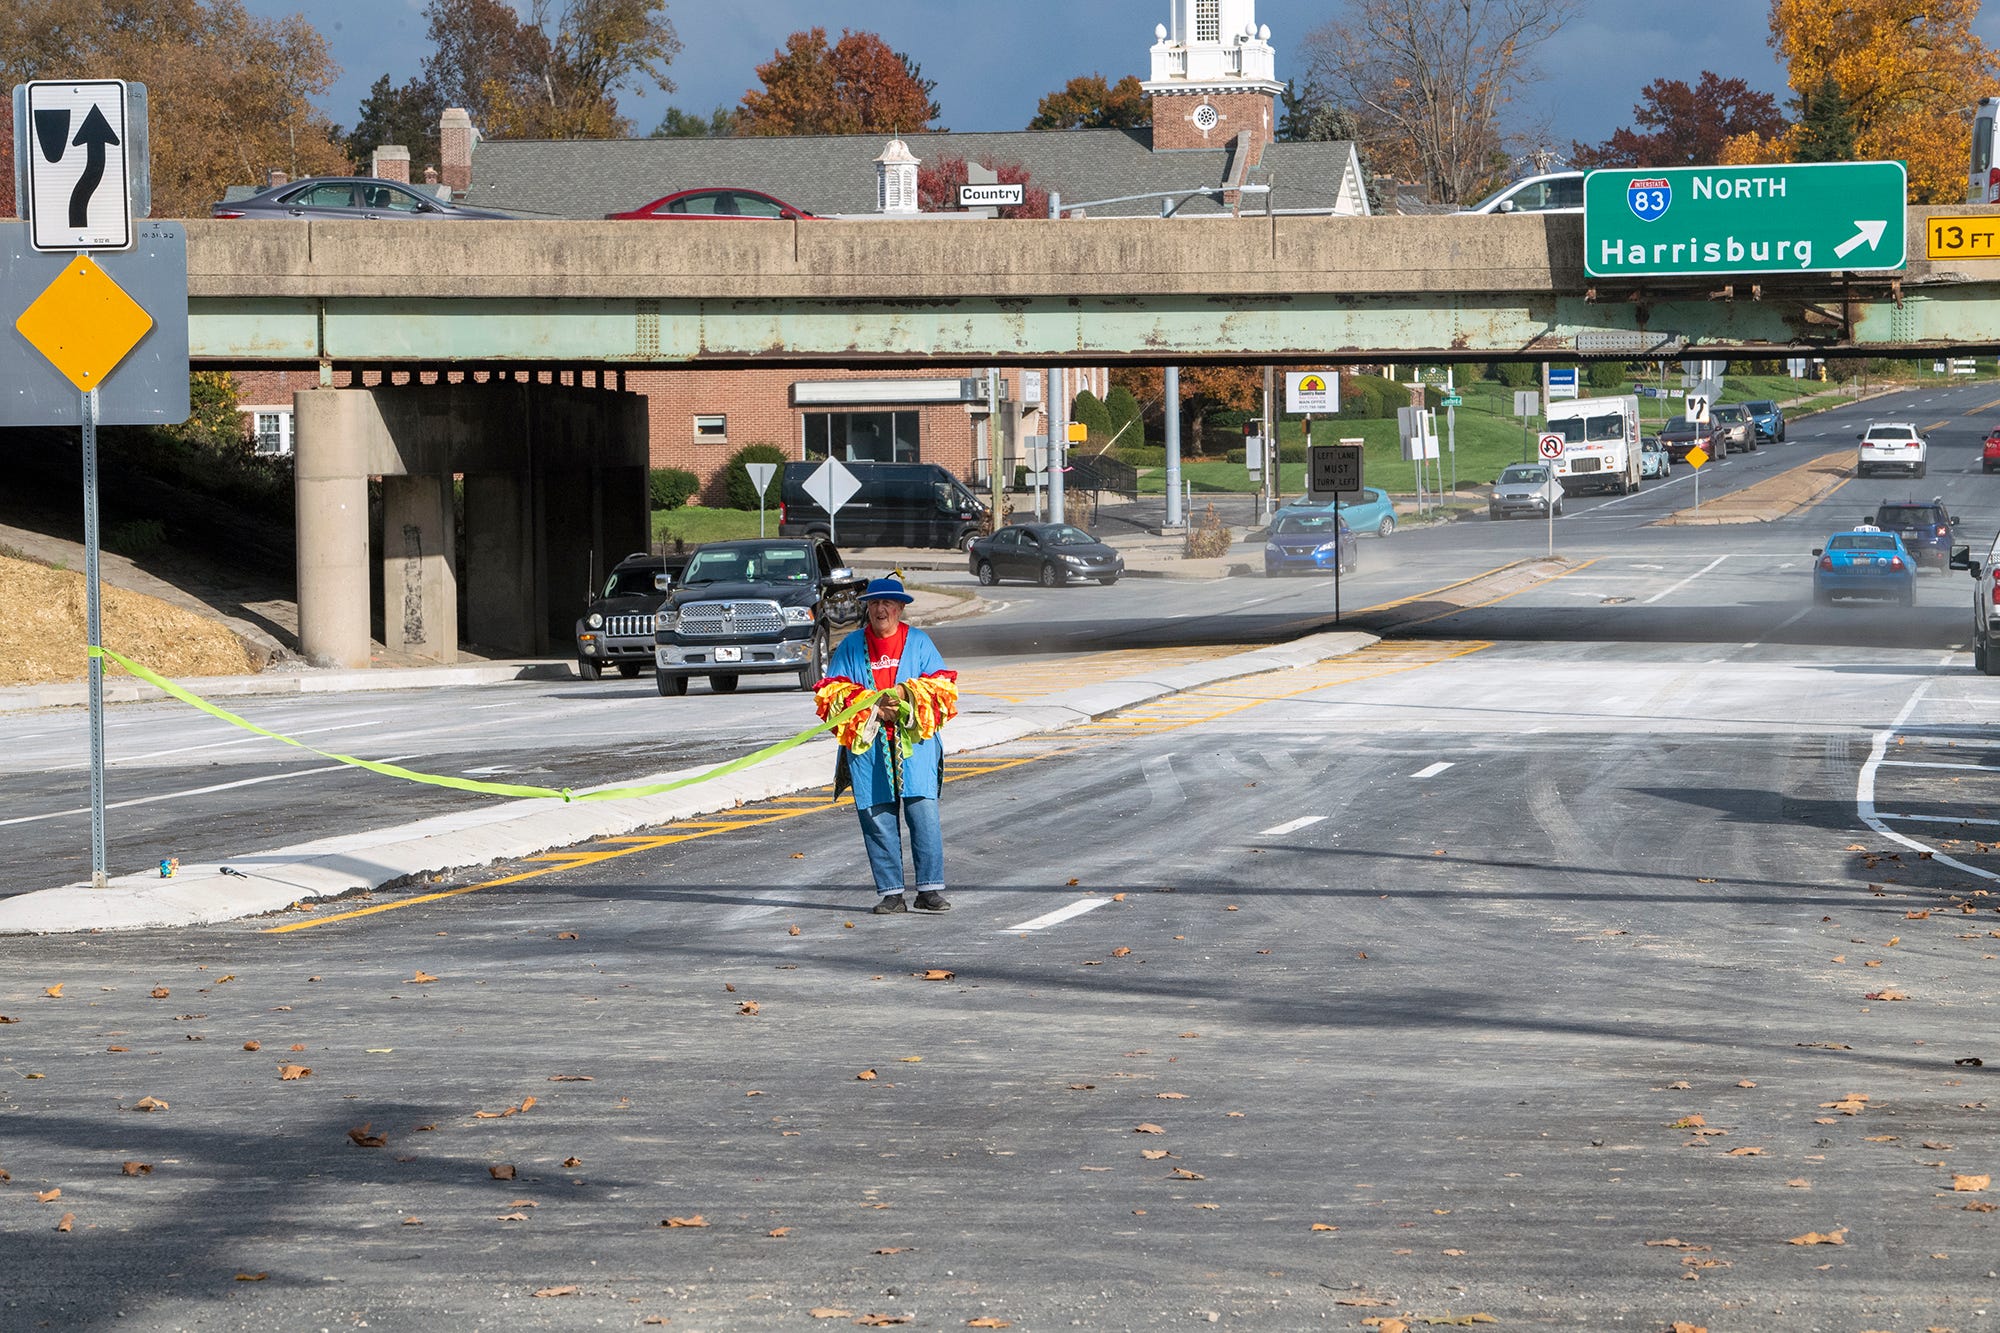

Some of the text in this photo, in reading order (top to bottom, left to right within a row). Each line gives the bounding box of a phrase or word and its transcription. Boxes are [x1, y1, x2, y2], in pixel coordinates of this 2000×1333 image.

[1634, 180, 1664, 188] INTERSTATE
[1692, 176, 1786, 200] NORTH
[962, 188, 1020, 202] Country
[1635, 191, 1664, 212] 83
[1935, 226, 1995, 249] 13 FT
[1601, 235, 1812, 269] Harrisburg
[1317, 452, 1333, 460] LEFT
[1324, 464, 1348, 473] MUST
[1317, 478, 1356, 486] TURN LEFT
